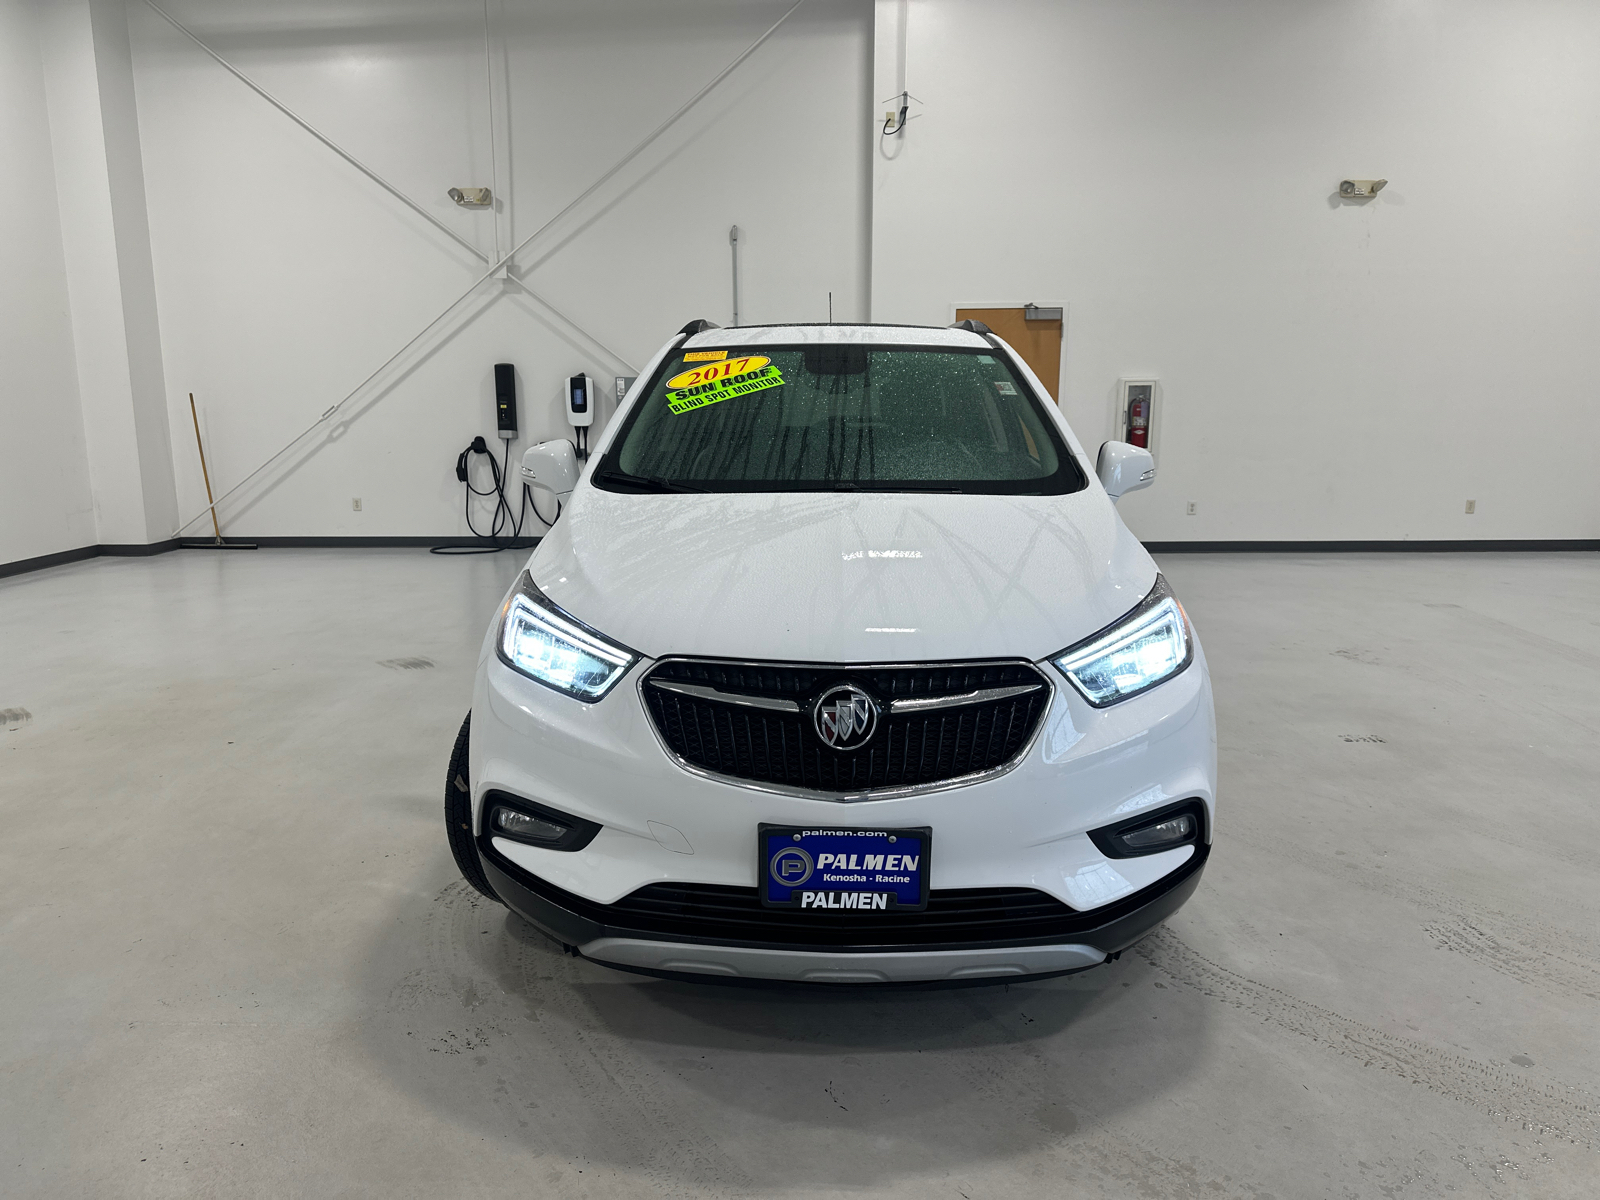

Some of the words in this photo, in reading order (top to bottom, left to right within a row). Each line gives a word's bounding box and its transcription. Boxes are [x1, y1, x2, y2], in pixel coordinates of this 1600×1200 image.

[688, 359, 750, 386] 2017
[671, 398, 704, 412] BLIND
[705, 390, 731, 402] SPOT
[735, 377, 780, 394] MONITOR
[675, 382, 716, 401] SUN
[720, 368, 773, 388] ROOF
[816, 854, 919, 871] PALMEN
[824, 874, 866, 882] Kenosha
[876, 874, 910, 883] Racine
[801, 892, 888, 910] PALMEN
